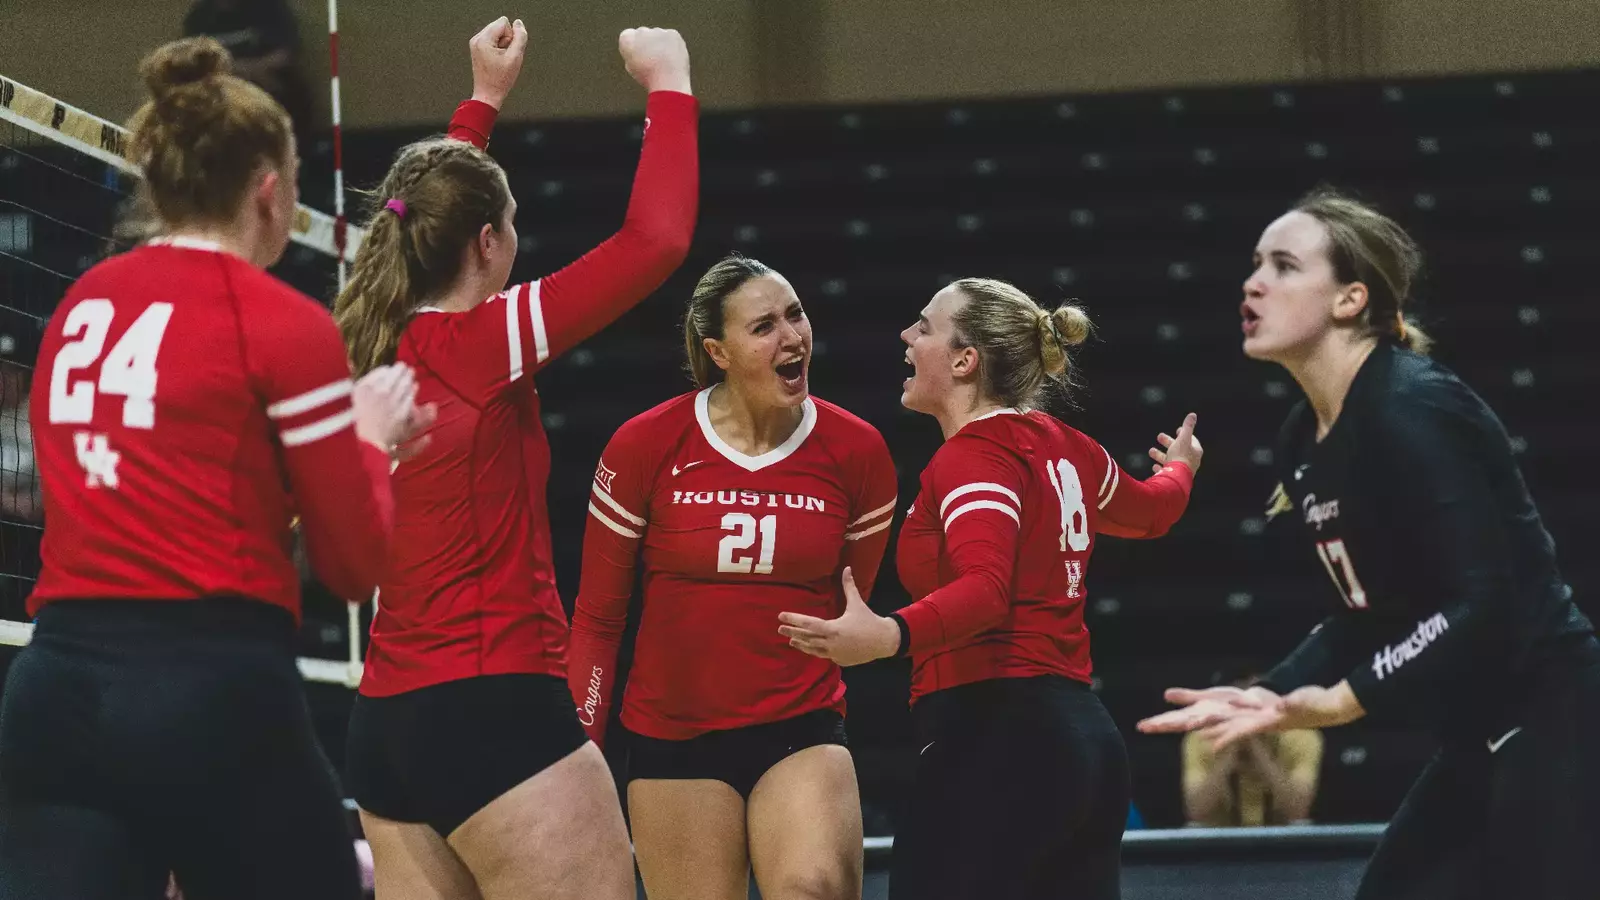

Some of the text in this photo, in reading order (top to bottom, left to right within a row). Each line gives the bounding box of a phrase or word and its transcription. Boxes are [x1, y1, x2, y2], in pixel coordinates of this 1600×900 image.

[49, 298, 174, 429] 24
[671, 490, 825, 512] HOUSTON
[1046, 458, 1090, 551] 18
[717, 512, 777, 574] 21
[1316, 539, 1368, 608] 17
[1372, 612, 1449, 680] Houston
[576, 665, 603, 726] Cougars
